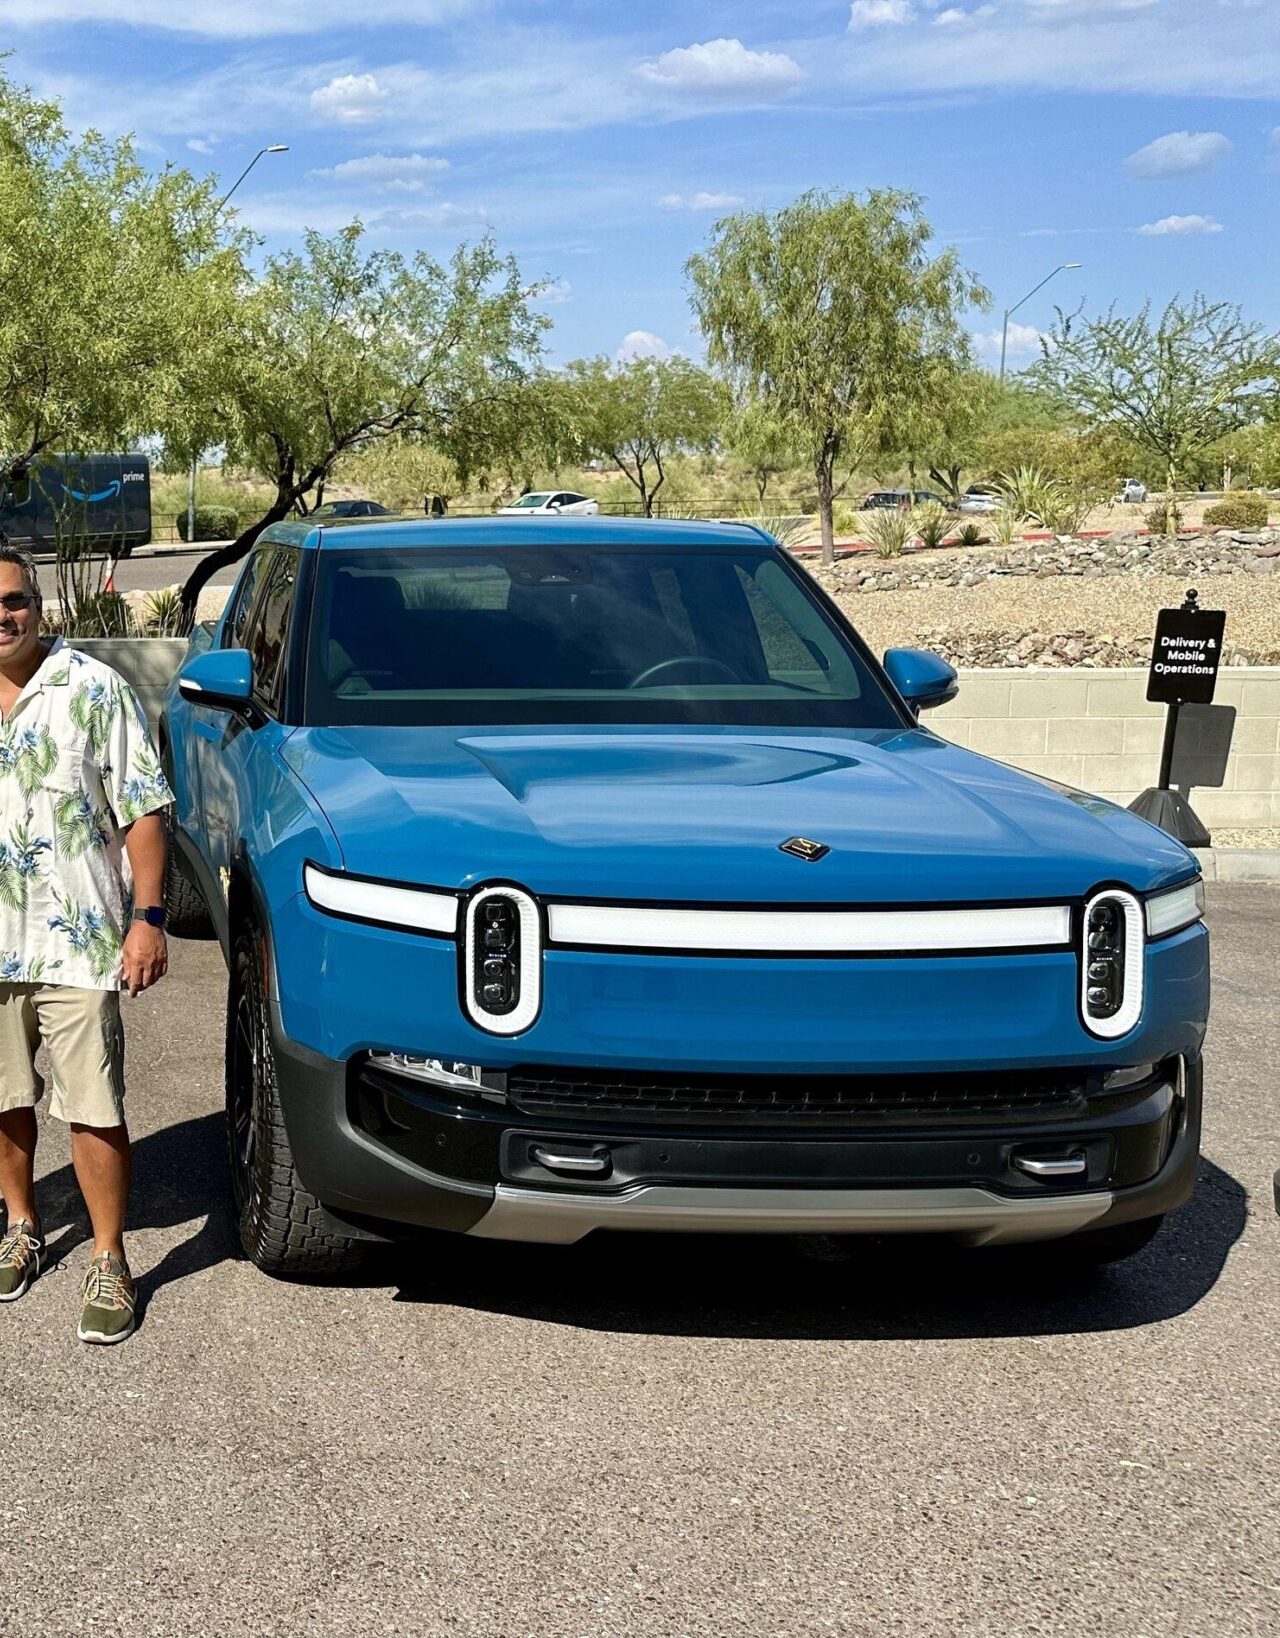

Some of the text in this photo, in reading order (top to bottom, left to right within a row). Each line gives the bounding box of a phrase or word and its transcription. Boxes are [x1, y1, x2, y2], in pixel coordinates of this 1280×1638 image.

[122, 471, 145, 484] prime
[1160, 636, 1217, 650] Delivery &
[1167, 650, 1206, 661] Mobile
[1154, 662, 1215, 675] Operations
